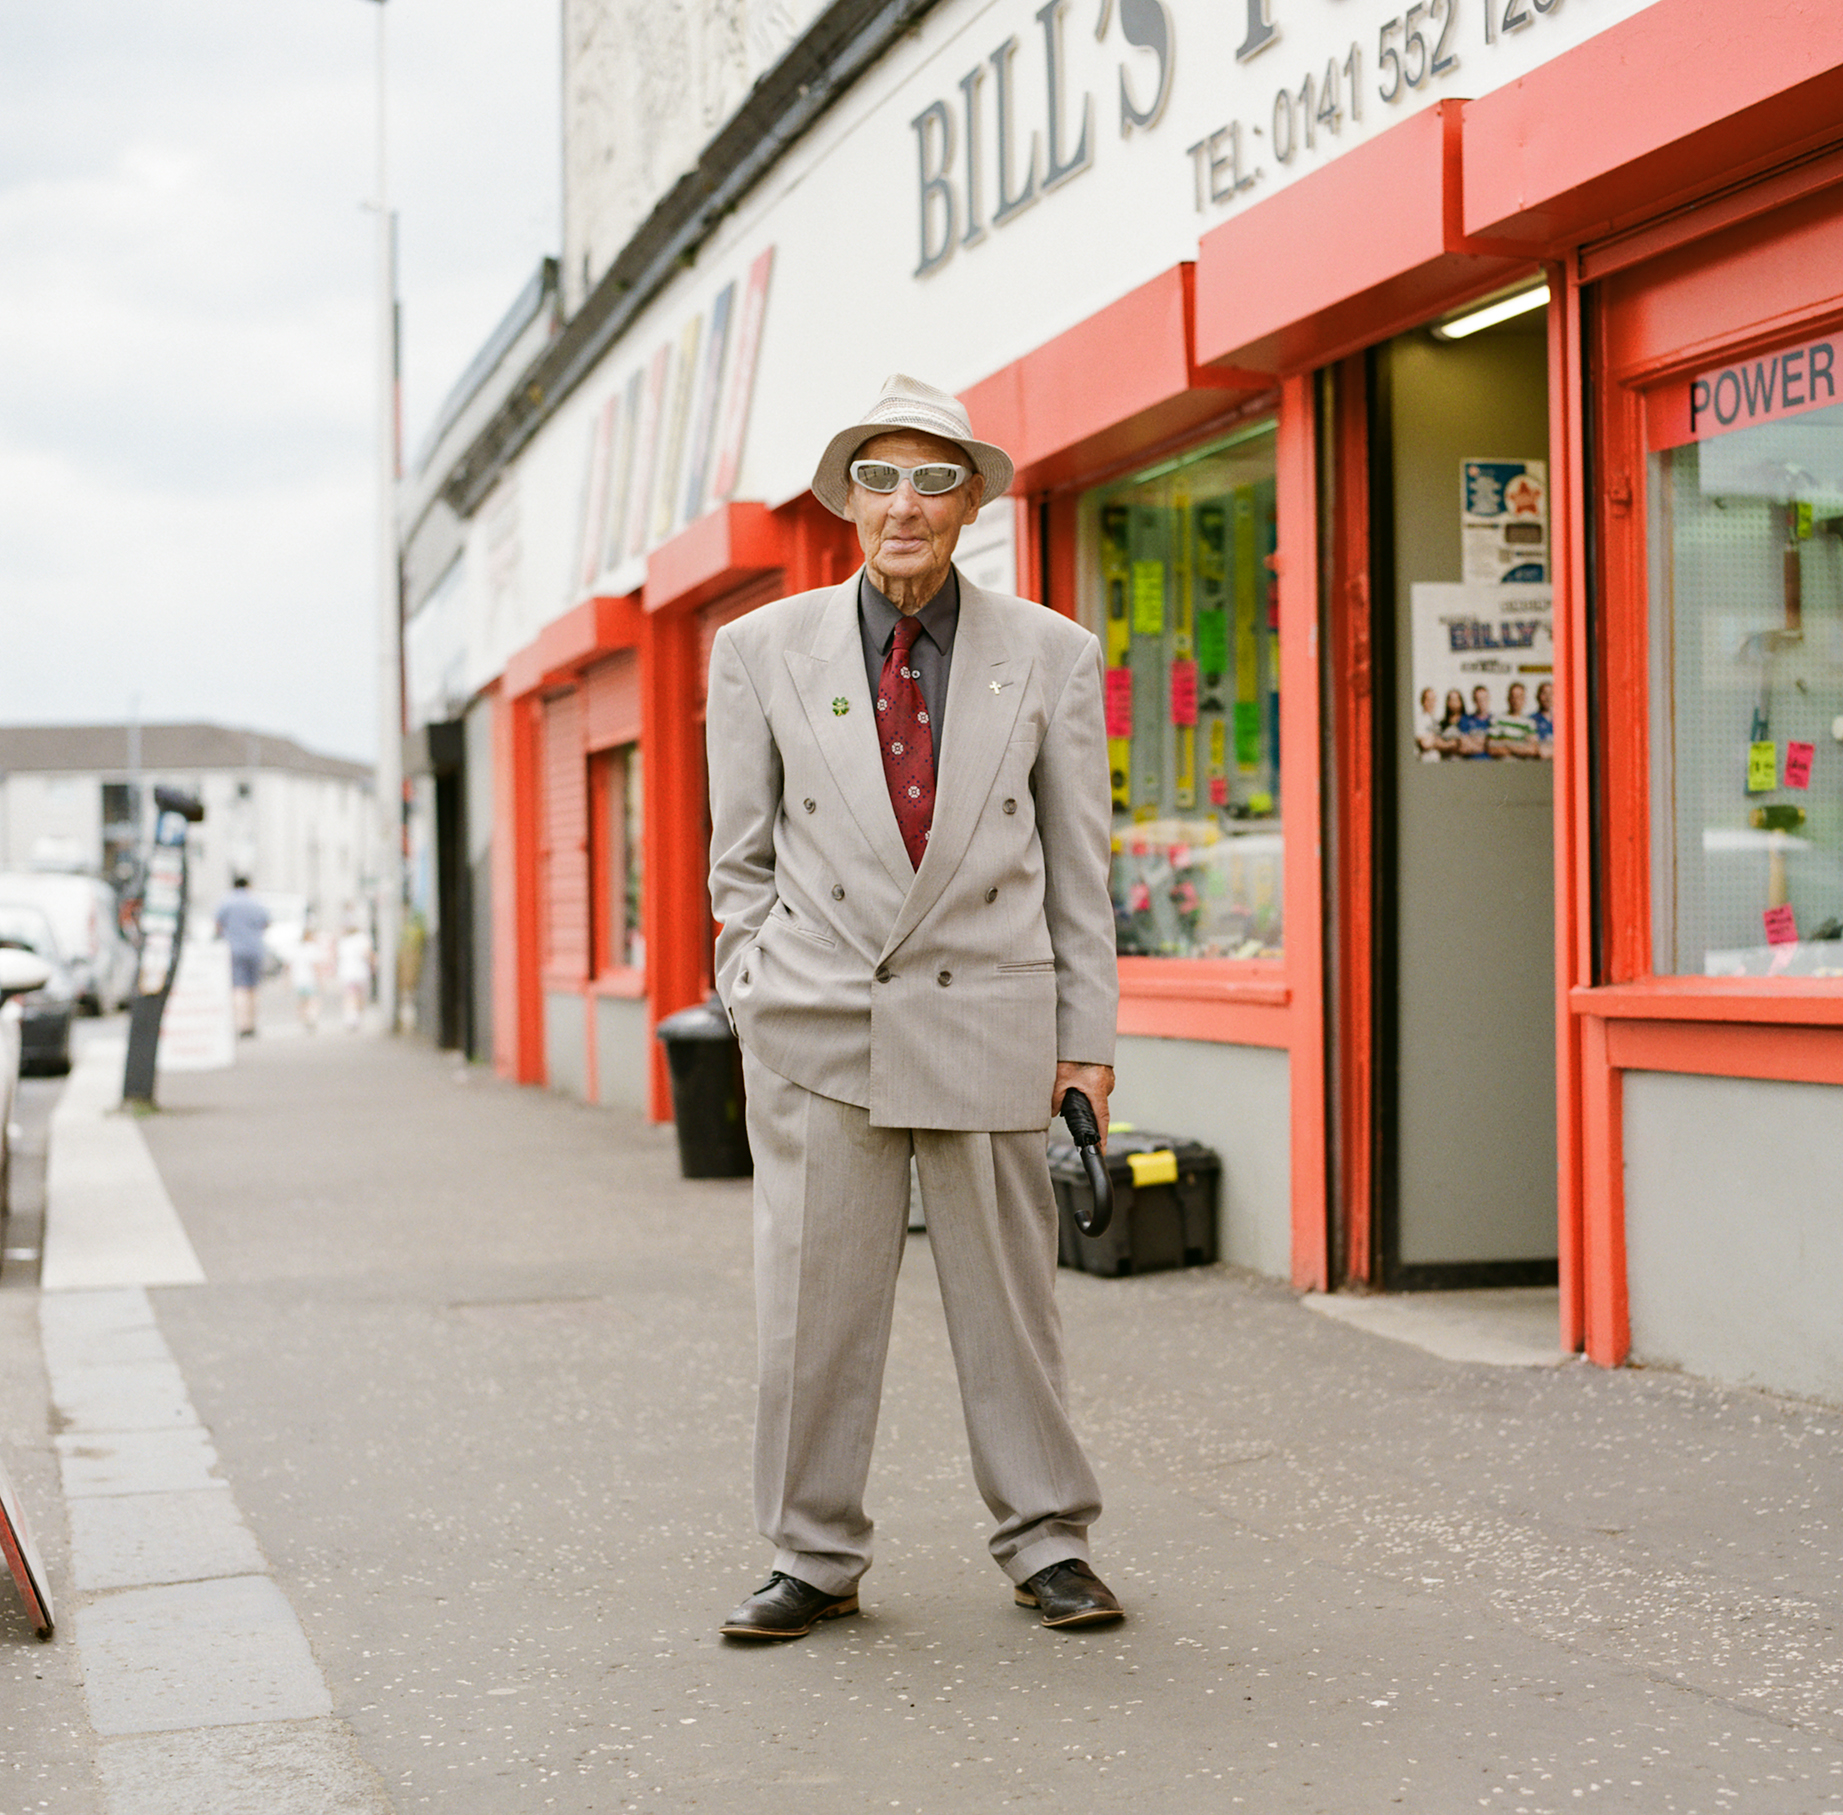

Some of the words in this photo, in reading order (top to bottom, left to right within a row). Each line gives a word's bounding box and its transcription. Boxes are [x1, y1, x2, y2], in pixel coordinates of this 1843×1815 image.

[911, 0, 1175, 282] BILL'S
[1186, 119, 1264, 213] TEL:
[1272, 40, 1362, 164] 0141
[1378, 0, 1460, 103] 552
[1690, 343, 1835, 433] POWER
